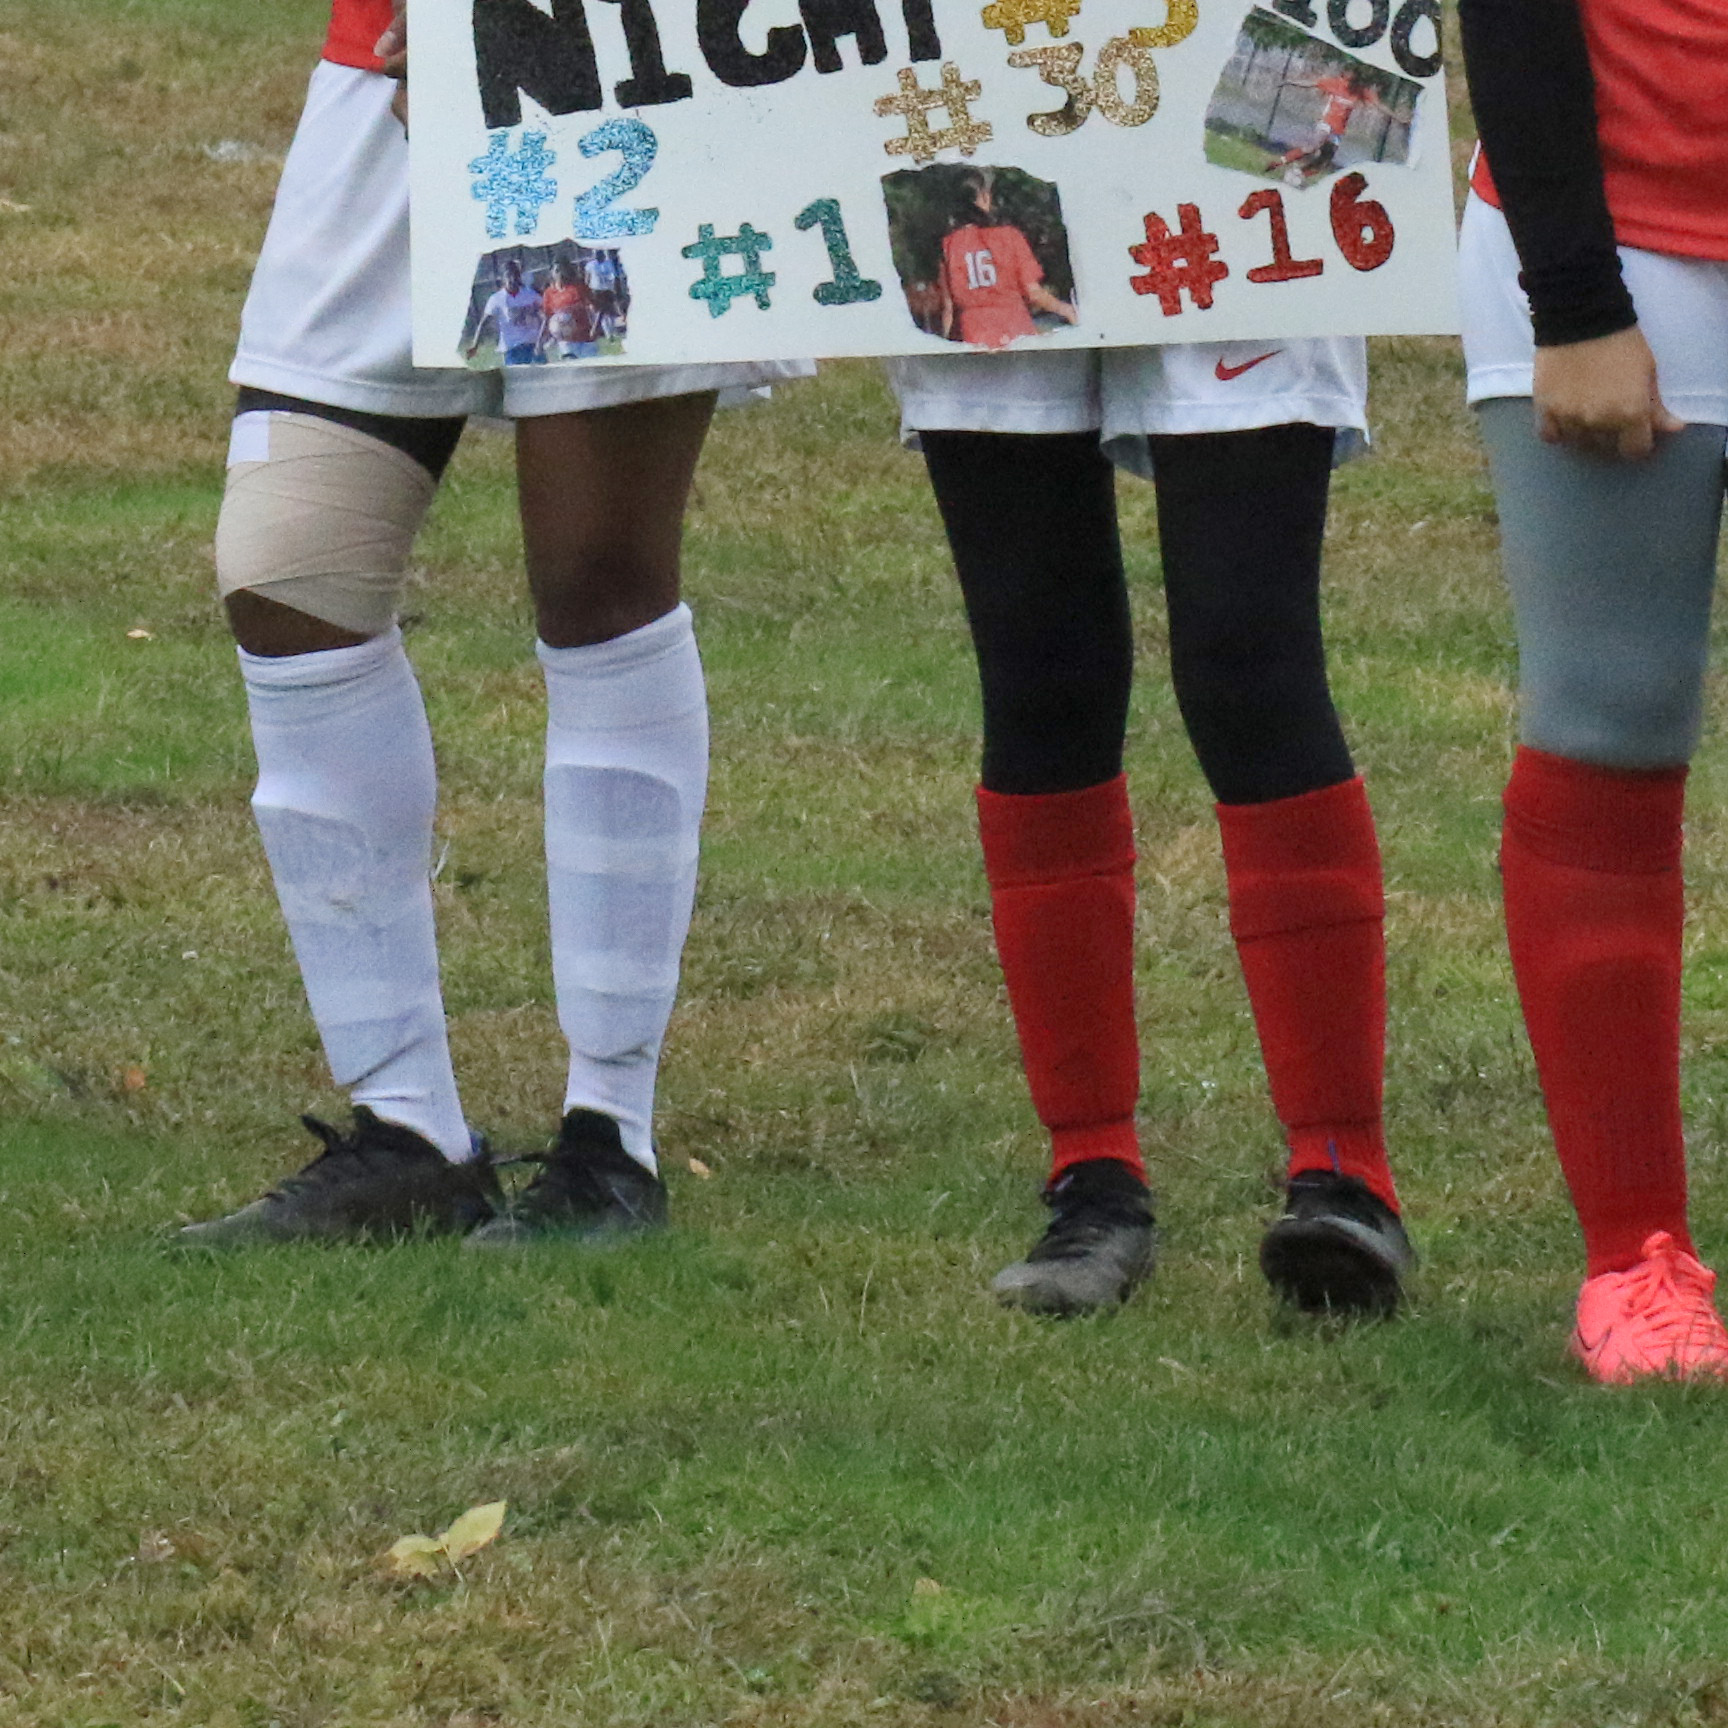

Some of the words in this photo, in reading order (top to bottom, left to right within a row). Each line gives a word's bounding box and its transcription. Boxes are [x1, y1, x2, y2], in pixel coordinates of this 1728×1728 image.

[469, 117, 659, 239] #2
[681, 197, 883, 317] #1
[964, 250, 997, 290] 16
[1128, 172, 1394, 316] #16
